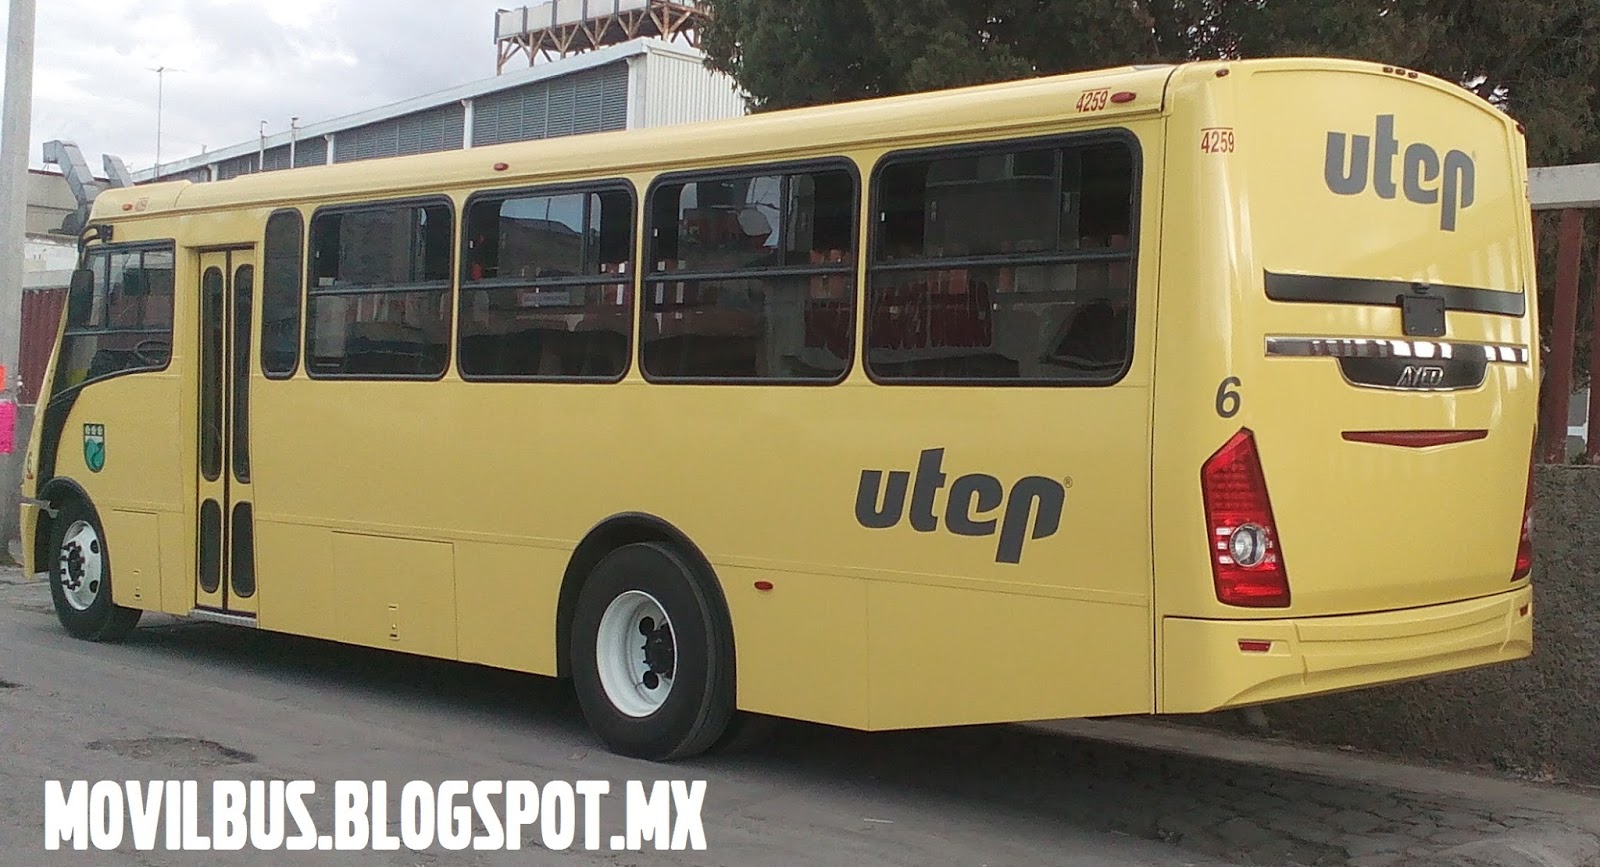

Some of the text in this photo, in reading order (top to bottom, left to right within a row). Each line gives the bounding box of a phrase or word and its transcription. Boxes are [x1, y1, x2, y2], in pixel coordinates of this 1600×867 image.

[1076, 90, 1109, 112] 4259
[1201, 131, 1235, 154] 4259
[1324, 114, 1475, 232] utep
[1215, 376, 1241, 418] 6
[855, 447, 1066, 564] utep
